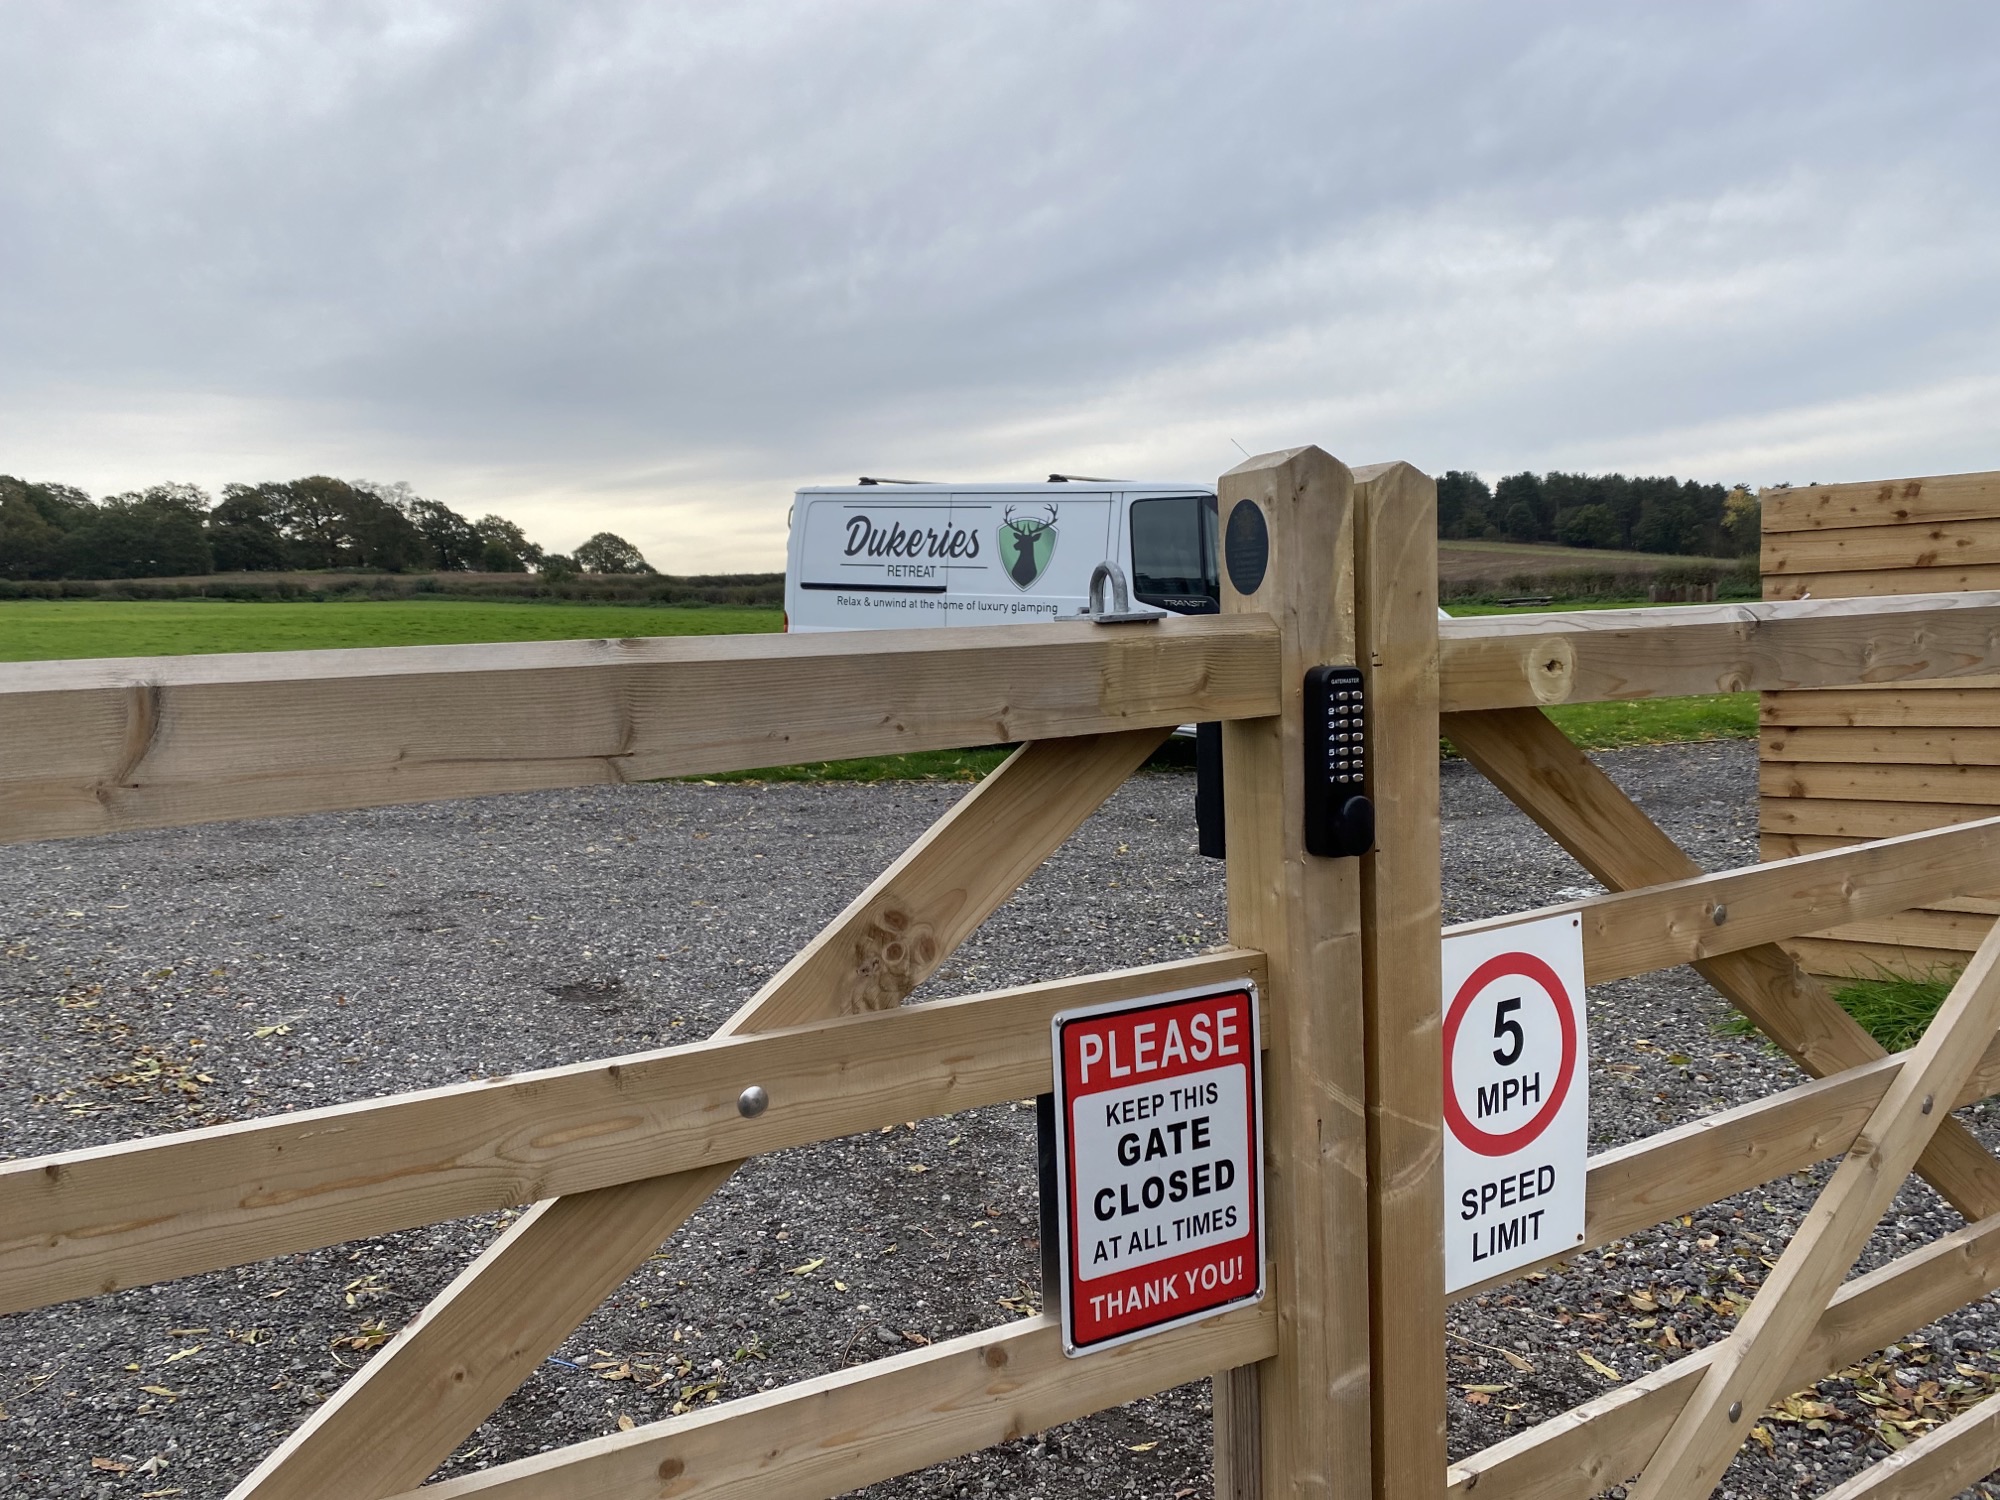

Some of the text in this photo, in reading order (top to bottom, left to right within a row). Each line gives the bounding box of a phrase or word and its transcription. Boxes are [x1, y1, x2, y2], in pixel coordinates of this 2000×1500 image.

[844, 515, 980, 559] Dukeries
[887, 565, 937, 578] RETREAT
[837, 595, 1058, 616] Relax & unwind at the home of luxury glamping
[1163, 599, 1207, 607] TRANSIT
[1328, 734, 1335, 742] 4
[1328, 748, 1335, 756] 5
[1329, 762, 1335, 770] X
[1079, 1007, 1240, 1084] PLEASE
[1492, 997, 1524, 1066] 5
[1106, 1081, 1219, 1127] KEEP THIS
[1477, 1072, 1541, 1119] MPH
[1117, 1116, 1212, 1167] GATE
[1093, 1158, 1235, 1222] CLOSED
[1460, 1164, 1556, 1221] SPEED
[1093, 1204, 1238, 1265] AT ALL TIMES
[1472, 1209, 1545, 1263] LIMIT
[1090, 1255, 1244, 1323] THANK YOU!
